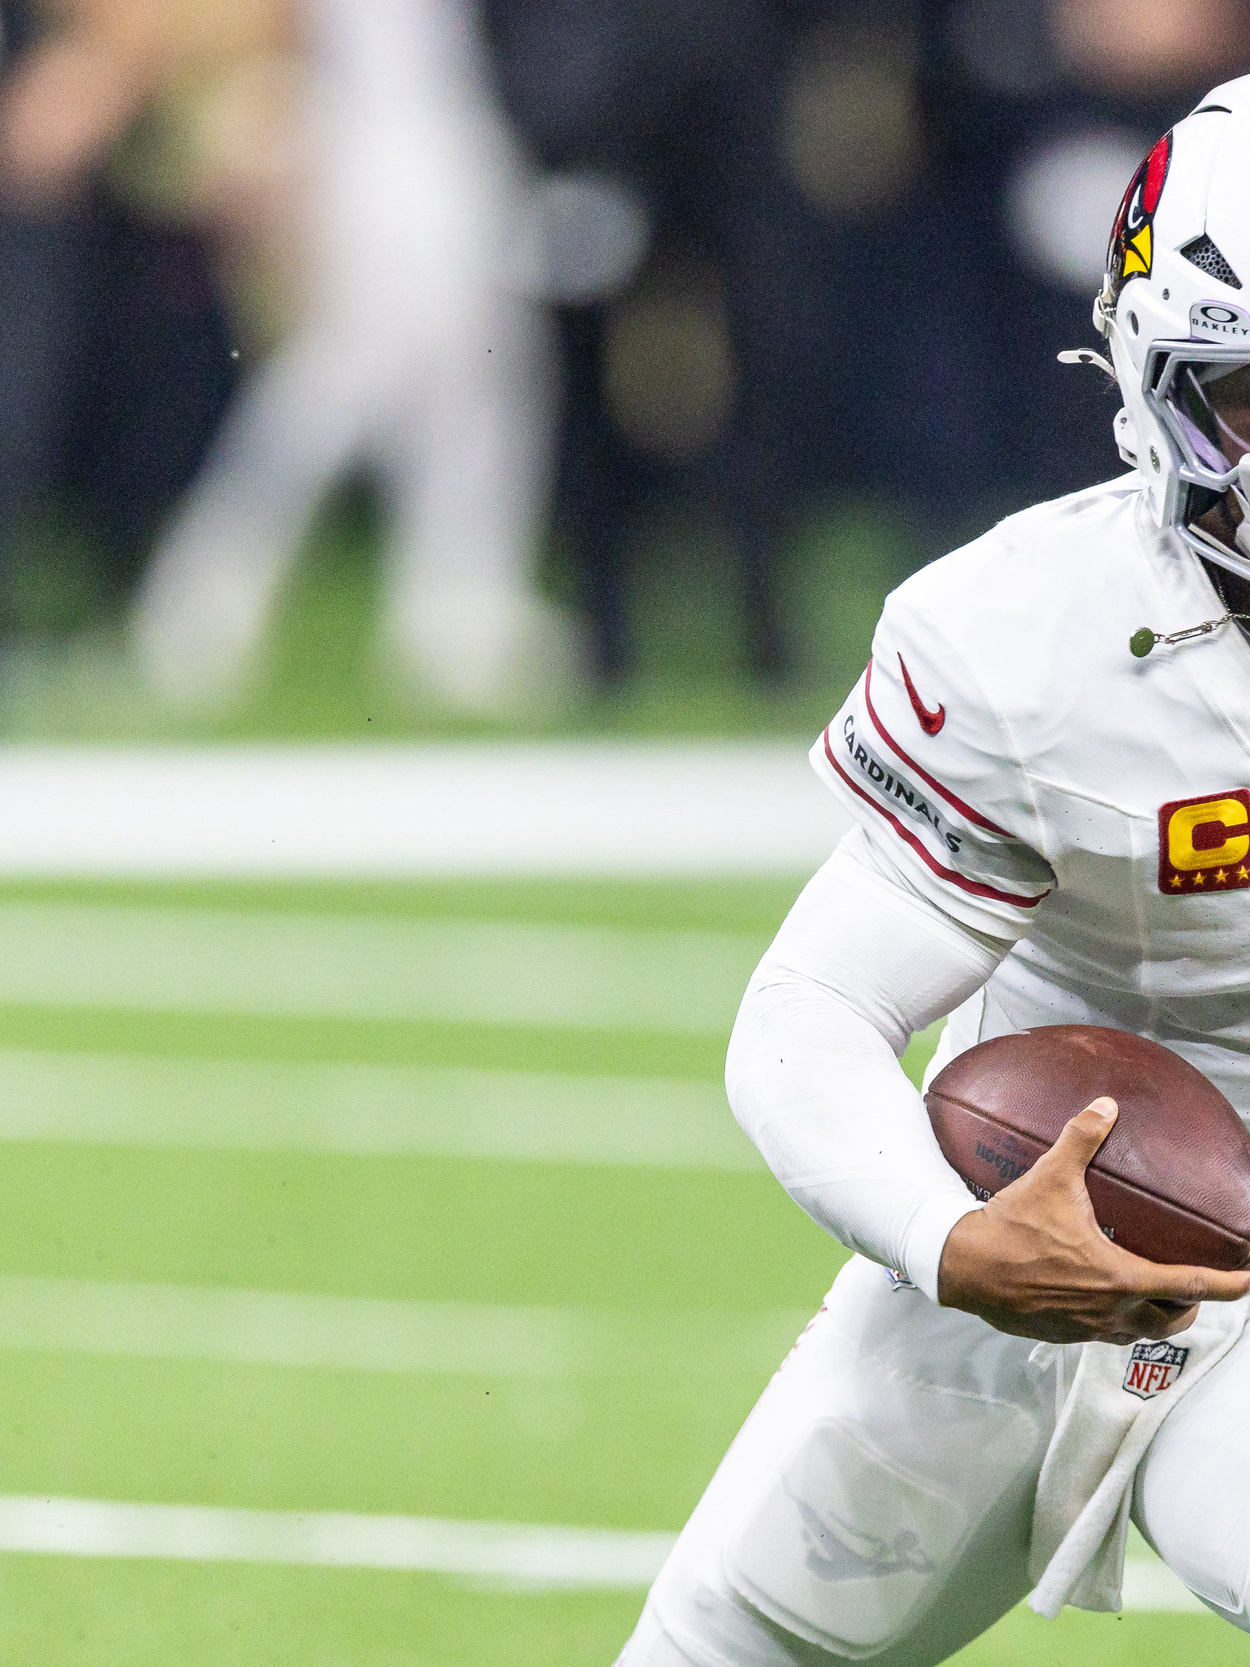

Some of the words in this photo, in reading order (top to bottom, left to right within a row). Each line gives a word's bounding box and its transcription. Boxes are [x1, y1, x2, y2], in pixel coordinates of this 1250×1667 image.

[1192, 318, 1249, 336] OAKLEY
[843, 714, 963, 853] CARDINALS
[1168, 798, 1250, 871] C
[1127, 1361, 1172, 1393] NFL
